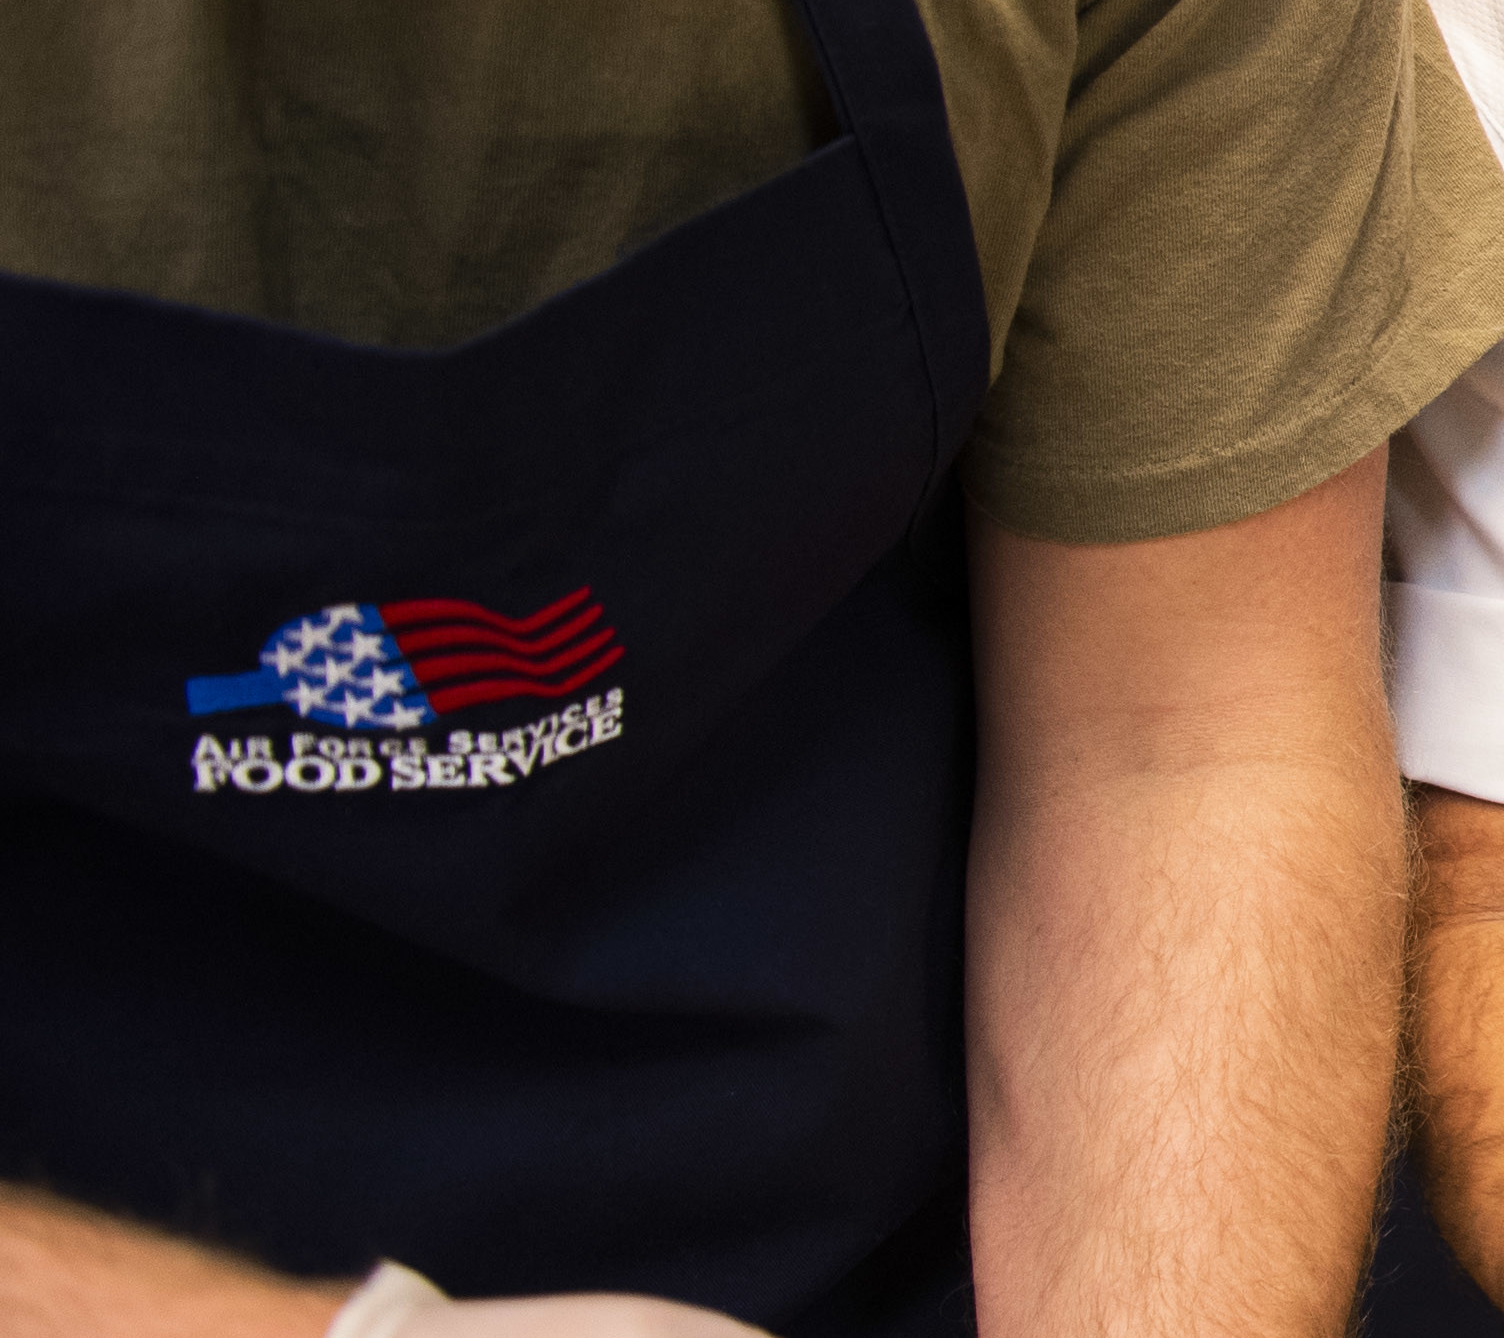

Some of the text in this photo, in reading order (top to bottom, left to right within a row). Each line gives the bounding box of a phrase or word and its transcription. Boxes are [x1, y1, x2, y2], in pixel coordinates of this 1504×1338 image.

[193, 708, 623, 792] FOOD SERVICE
[194, 687, 624, 760] AIR FORCE SERVICES
